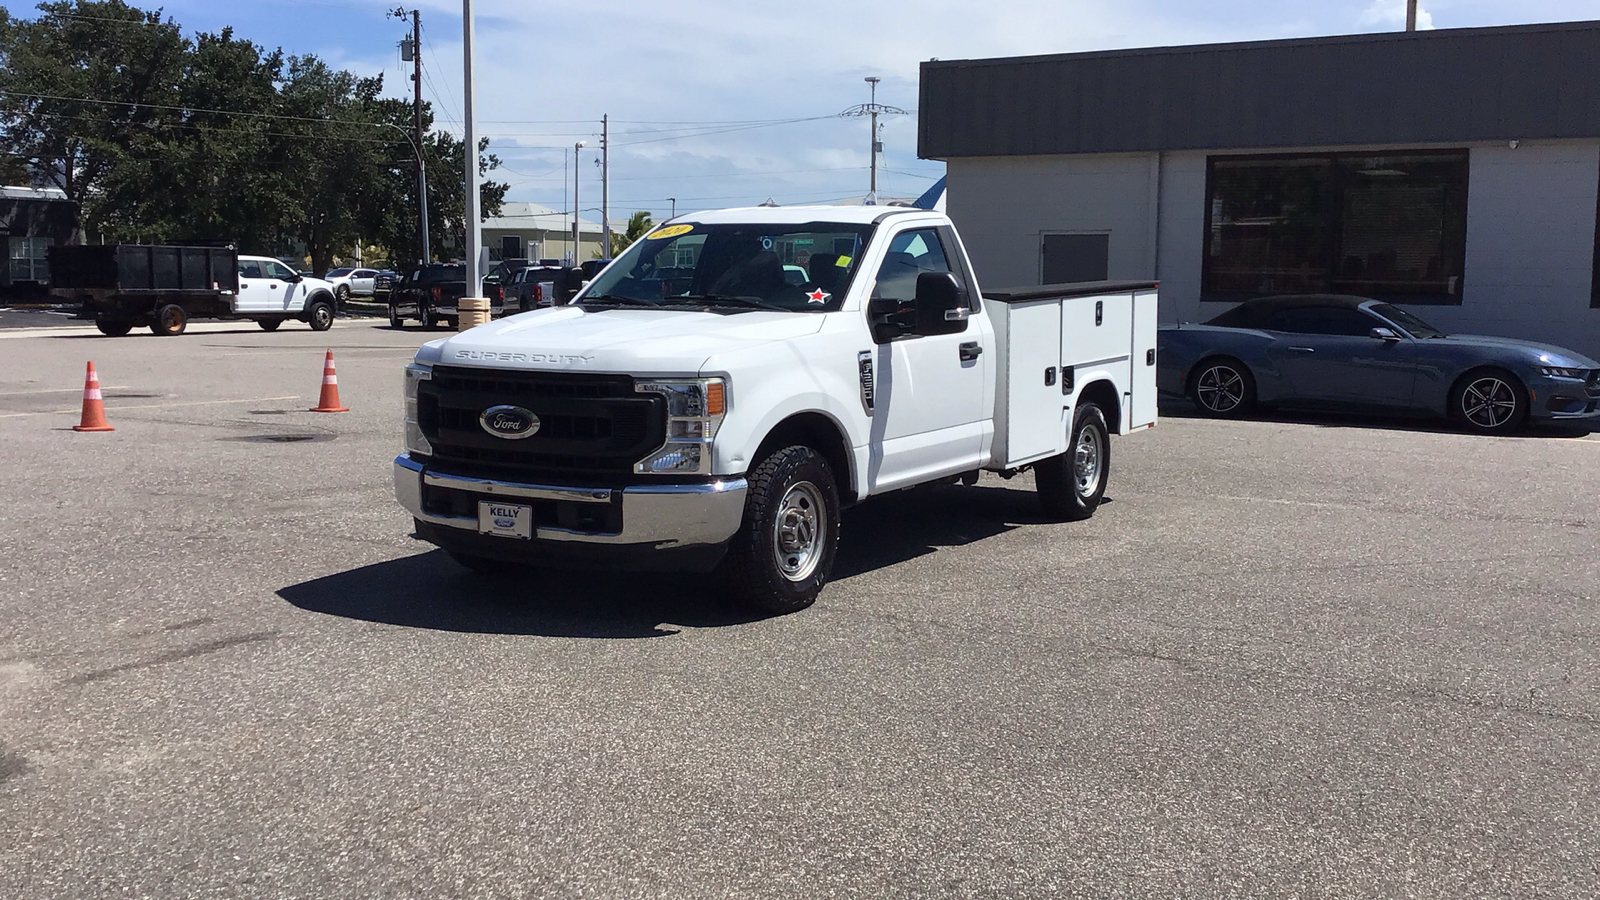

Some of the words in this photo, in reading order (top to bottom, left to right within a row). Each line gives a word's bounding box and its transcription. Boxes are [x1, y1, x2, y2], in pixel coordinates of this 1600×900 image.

[455, 350, 527, 362] SUPER
[529, 354, 595, 365] DUTY
[493, 413, 522, 430] Ford
[490, 507, 519, 518] KELLY
